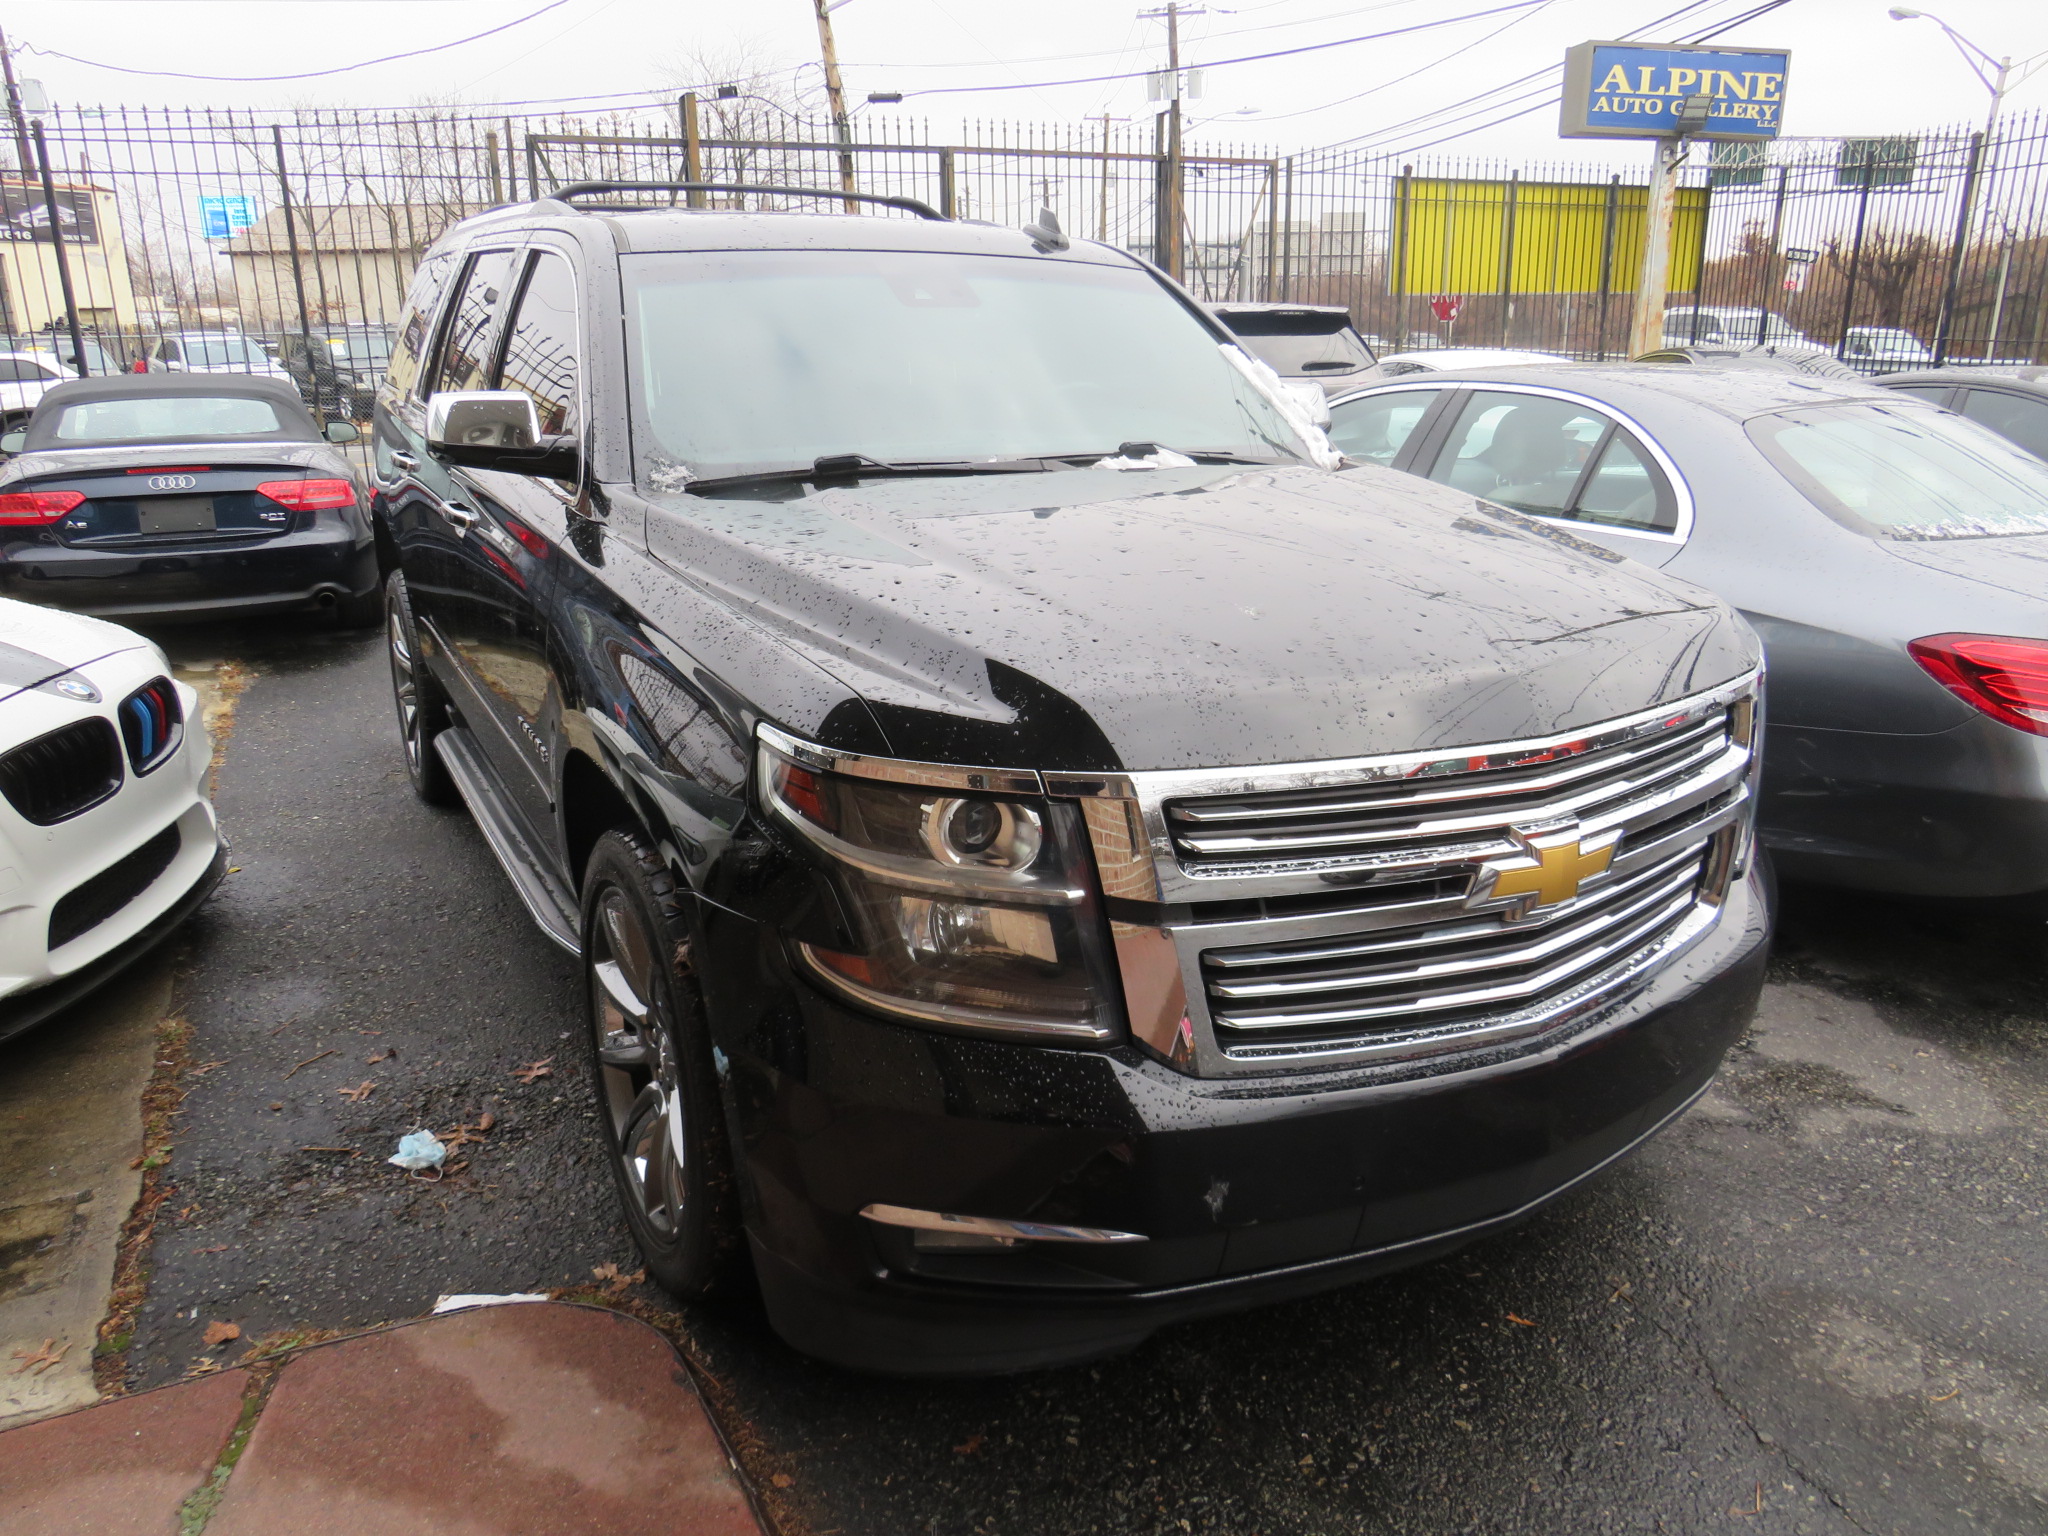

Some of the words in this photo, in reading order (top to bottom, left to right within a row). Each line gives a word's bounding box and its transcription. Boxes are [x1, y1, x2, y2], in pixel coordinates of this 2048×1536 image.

[1594, 64, 1783, 102] ALPINE
[1592, 96, 1663, 115] AUTO
[1670, 100, 1777, 120] GLLERY
